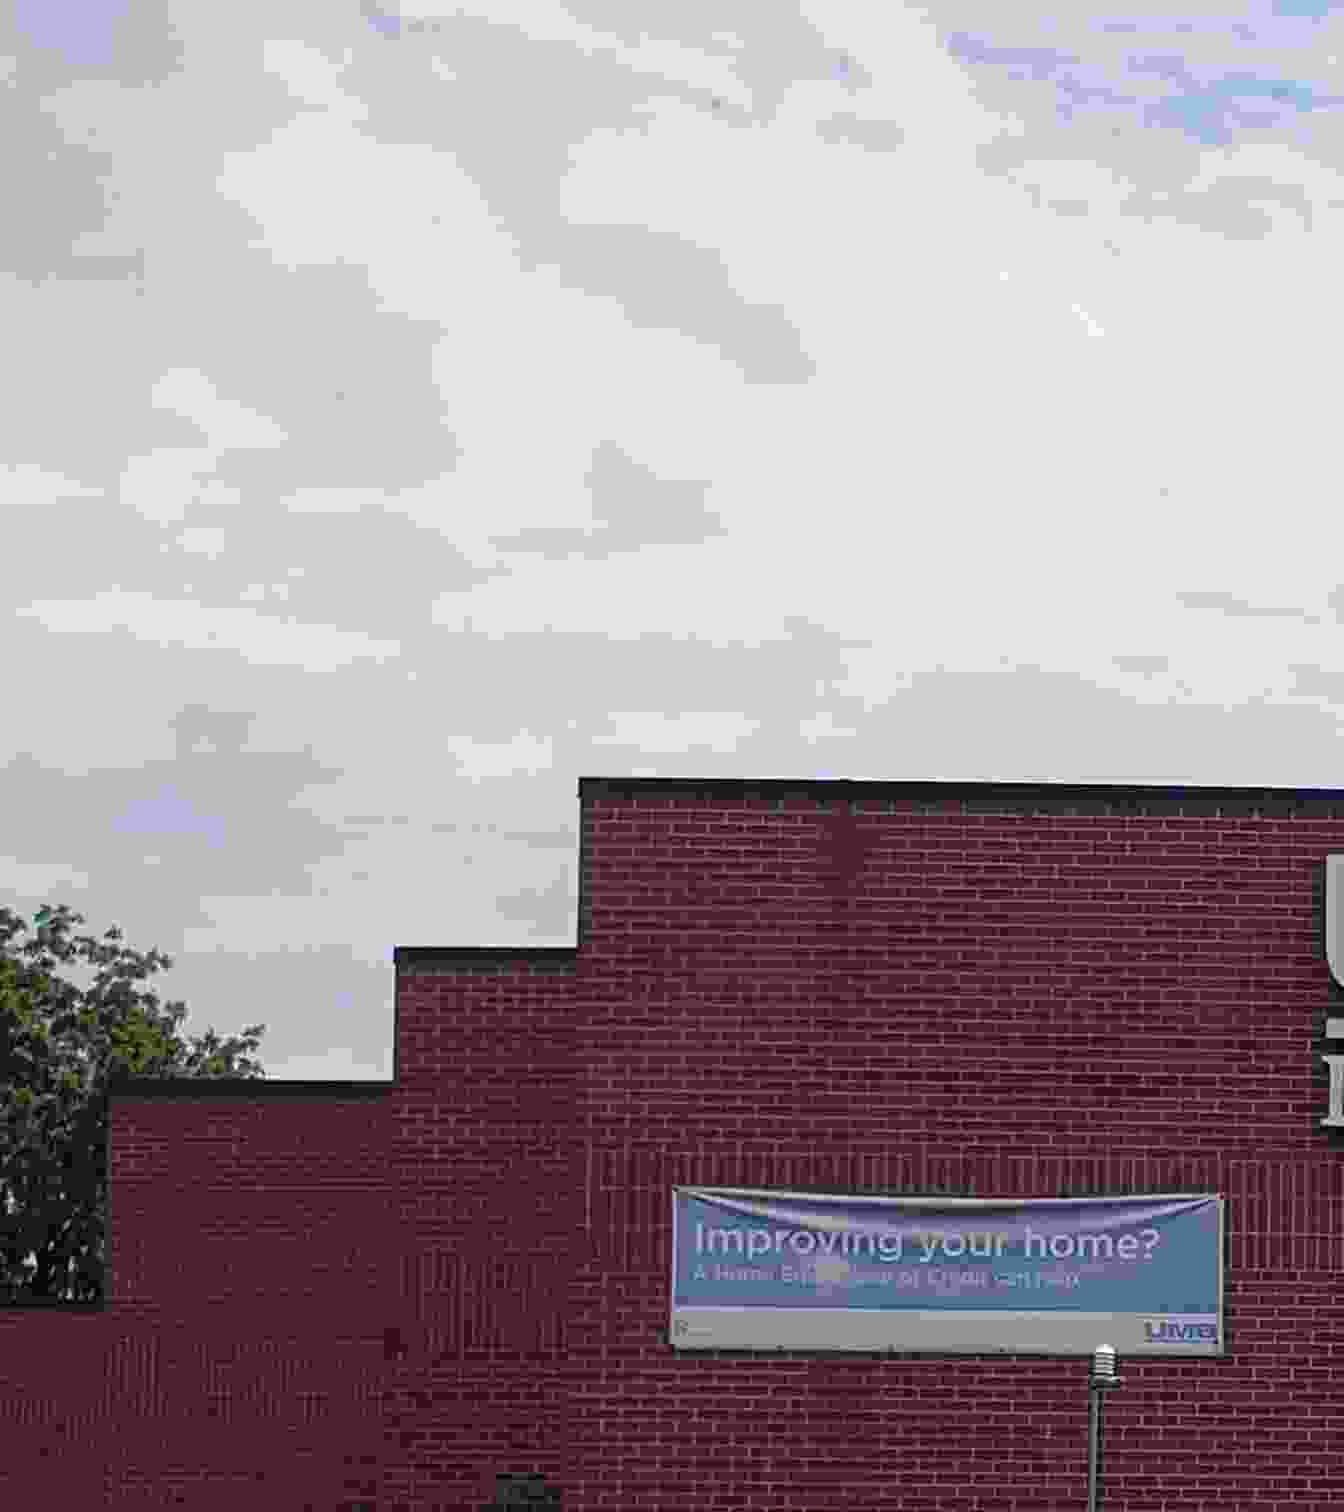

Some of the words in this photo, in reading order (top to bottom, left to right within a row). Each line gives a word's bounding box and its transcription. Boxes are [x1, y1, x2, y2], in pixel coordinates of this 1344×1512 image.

[695, 1223, 902, 1263] Improving
[920, 1230, 1008, 1263] your
[1024, 1225, 1160, 1264] home?
